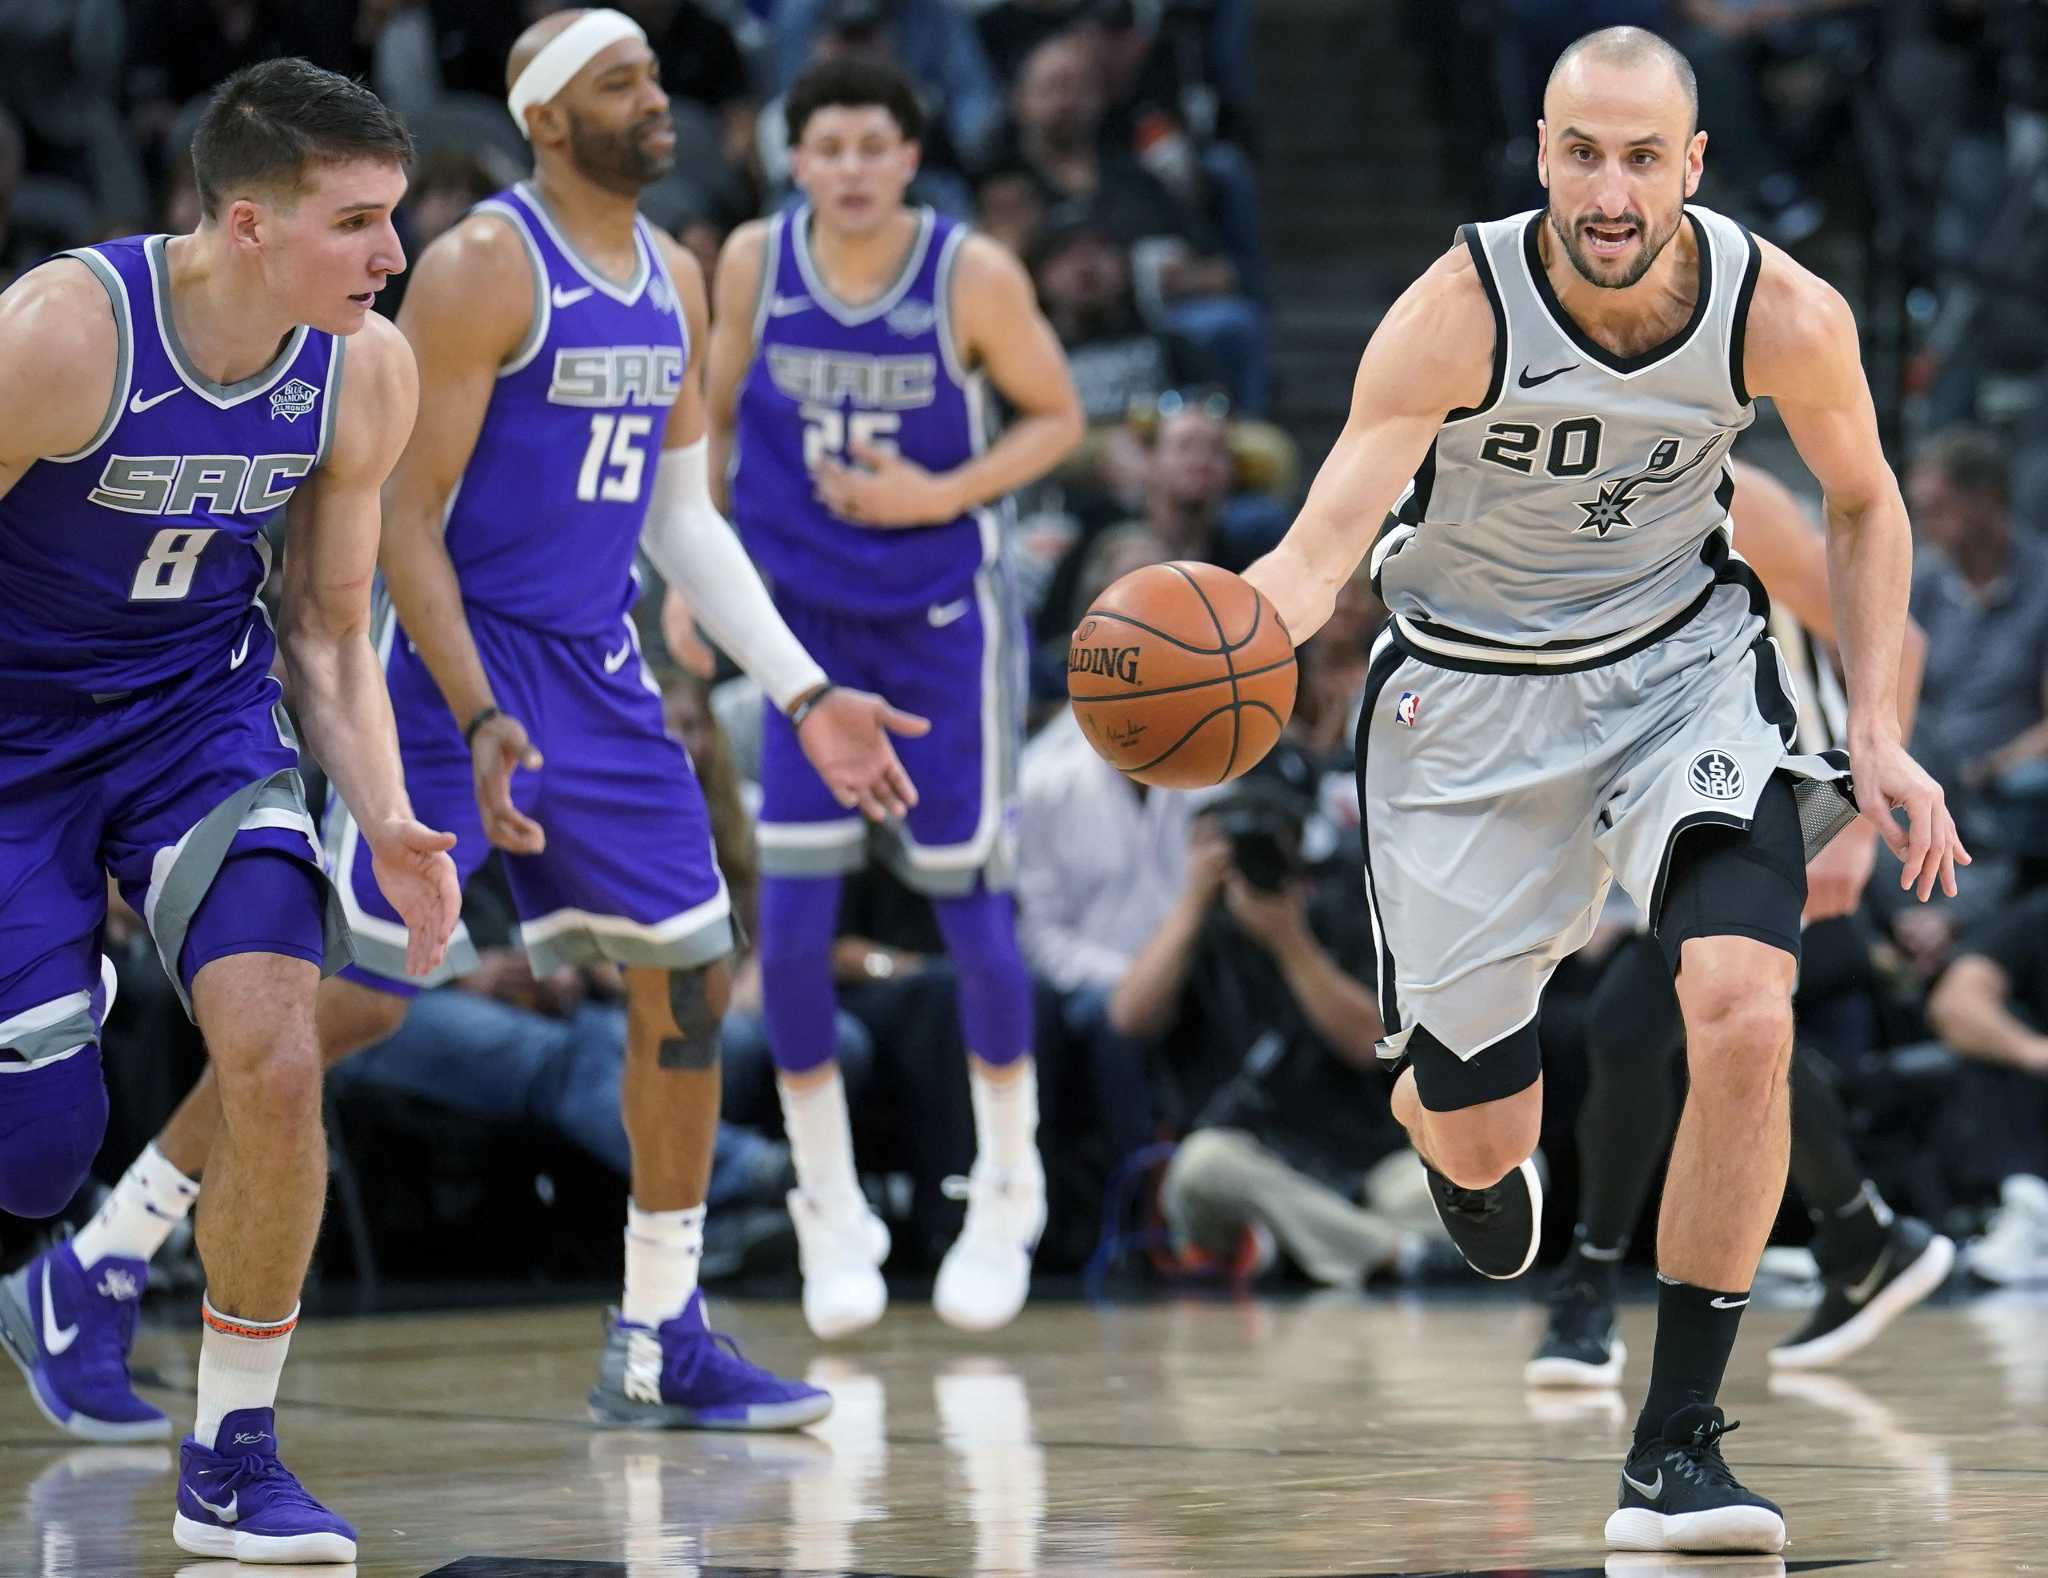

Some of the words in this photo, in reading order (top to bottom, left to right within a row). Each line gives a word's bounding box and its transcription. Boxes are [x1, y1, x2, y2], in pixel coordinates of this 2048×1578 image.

[275, 391, 312, 403] DIAMOND
[547, 345, 684, 408] SAC
[767, 345, 937, 411] SAC
[576, 413, 653, 503] 15
[1479, 414, 1606, 480] 20
[87, 453, 316, 516] SAC
[128, 528, 224, 603] 8
